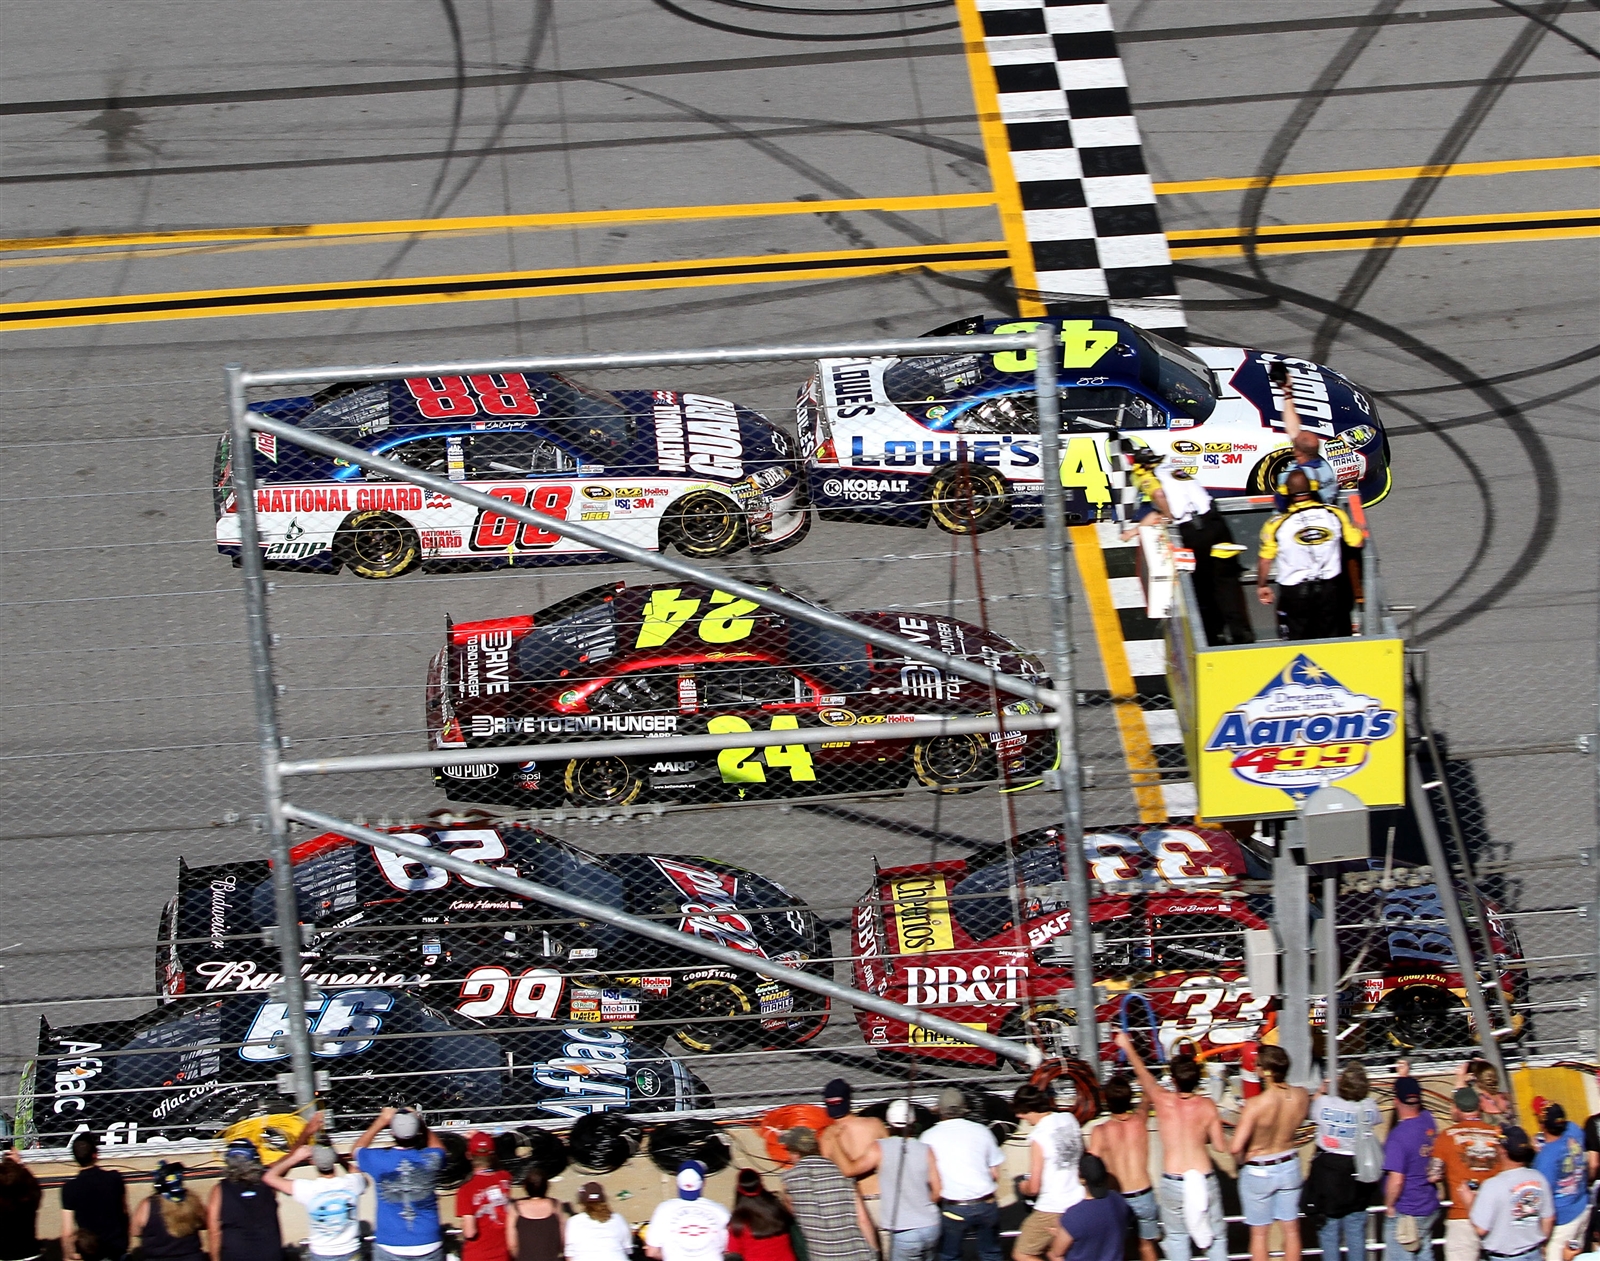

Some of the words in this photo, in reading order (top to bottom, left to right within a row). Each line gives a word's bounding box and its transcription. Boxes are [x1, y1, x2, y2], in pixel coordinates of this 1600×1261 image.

[653, 404, 687, 472] NATIONAL
[683, 392, 744, 479] GUARD
[852, 435, 1041, 467] LOWE'S
[1204, 454, 1219, 465] USG
[1221, 454, 1242, 464] 3M
[1333, 455, 1360, 467] MAHLE
[257, 488, 351, 512] NATIONAL
[356, 487, 423, 511] GUARD
[843, 479, 907, 492] KOBALT
[843, 491, 881, 501] TOOLS
[474, 483, 575, 550] 88
[615, 499, 631, 509] USG
[632, 498, 654, 508] 3M
[422, 536, 462, 549] GUARD
[635, 587, 767, 649] 24
[467, 661, 480, 698] HUNGER
[1274, 692, 1334, 703] Dreams
[472, 715, 535, 737] DRIVE
[540, 717, 562, 733] TO
[564, 716, 600, 733] END
[603, 715, 677, 732] HUNGER
[1207, 708, 1396, 750] Aaron's
[706, 714, 817, 784] 24
[513, 772, 541, 782] pepsi
[649, 761, 695, 772] AARP
[370, 828, 521, 892] 29
[1081, 828, 1228, 892] 33
[896, 878, 937, 949] Cheerios
[1028, 912, 1072, 947] SKF
[456, 965, 566, 1019] 29
[602, 988, 620, 1000] USG
[642, 977, 671, 986] Holley
[761, 988, 790, 1002] MOOG
[903, 965, 1029, 1007] BB&T
[761, 998, 794, 1014] MAHLE
[53, 1040, 103, 1114] Aflac
[152, 1078, 219, 1119] aflac.com
